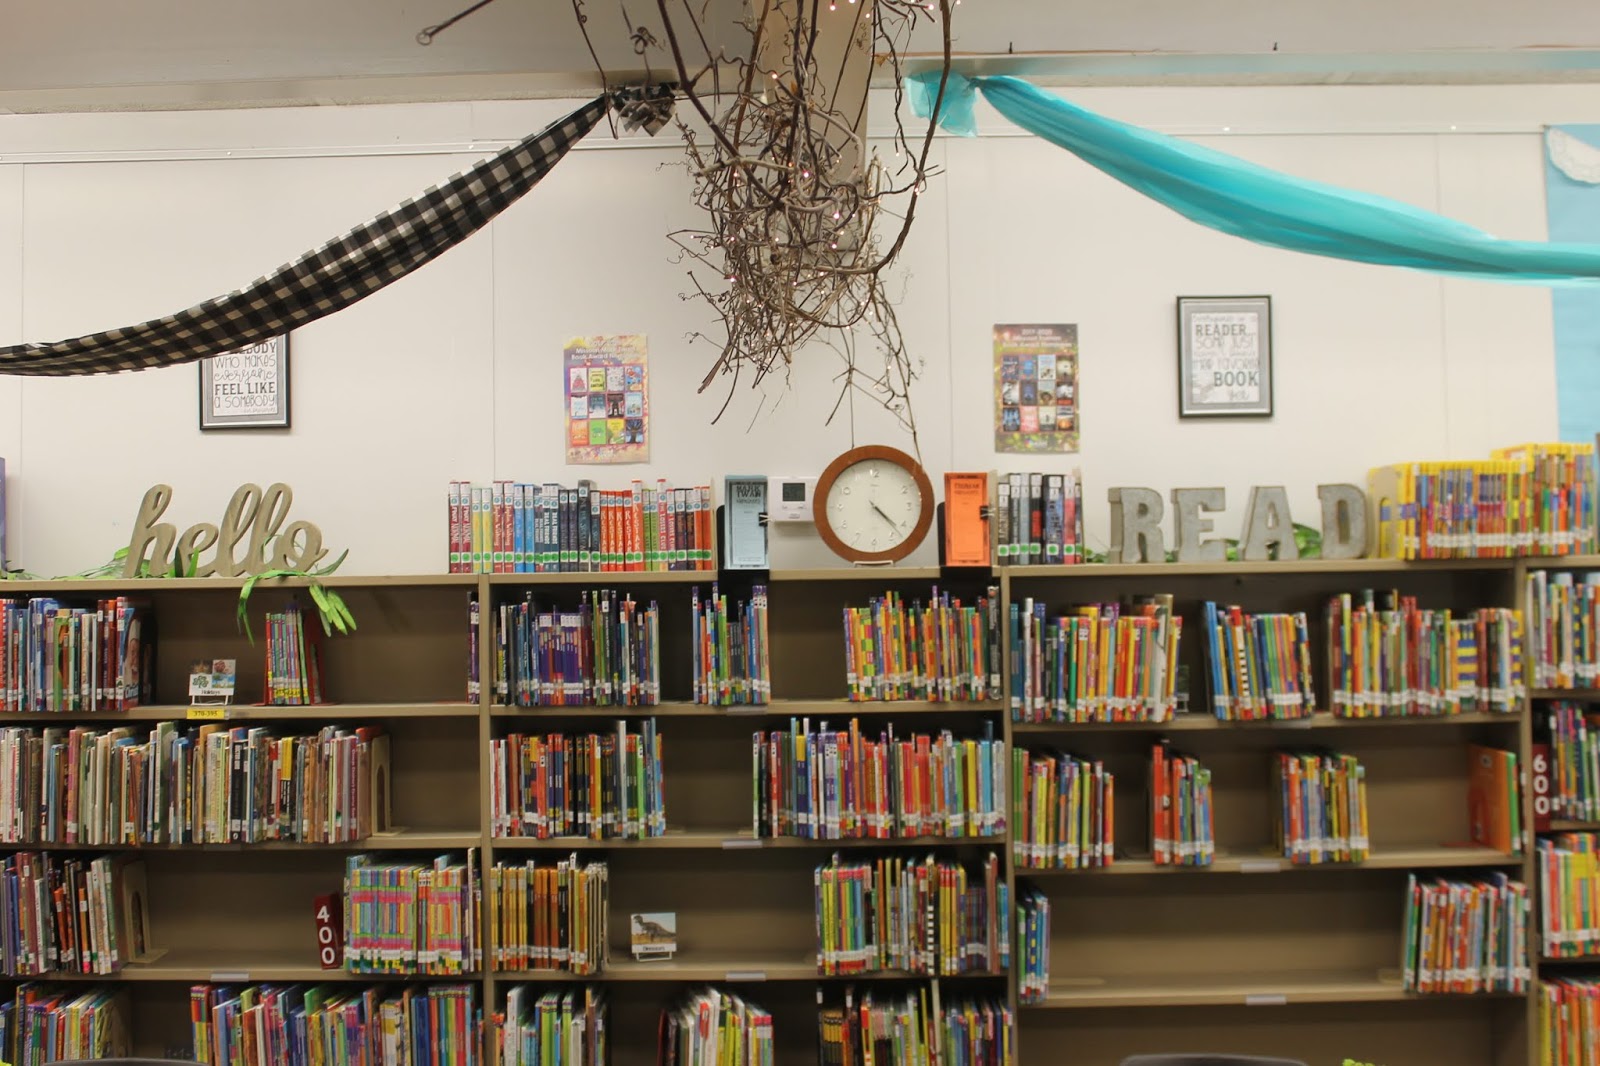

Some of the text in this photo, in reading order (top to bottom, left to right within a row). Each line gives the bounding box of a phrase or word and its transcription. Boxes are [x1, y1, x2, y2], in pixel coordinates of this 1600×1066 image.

[1196, 324, 1247, 336] READER
[215, 382, 275, 395] FEEL LIKE
[1214, 372, 1258, 387] BOOK
[122, 482, 329, 578] hello
[1108, 484, 1368, 563] READ
[1534, 754, 1550, 815] 600
[316, 906, 335, 964] 400
